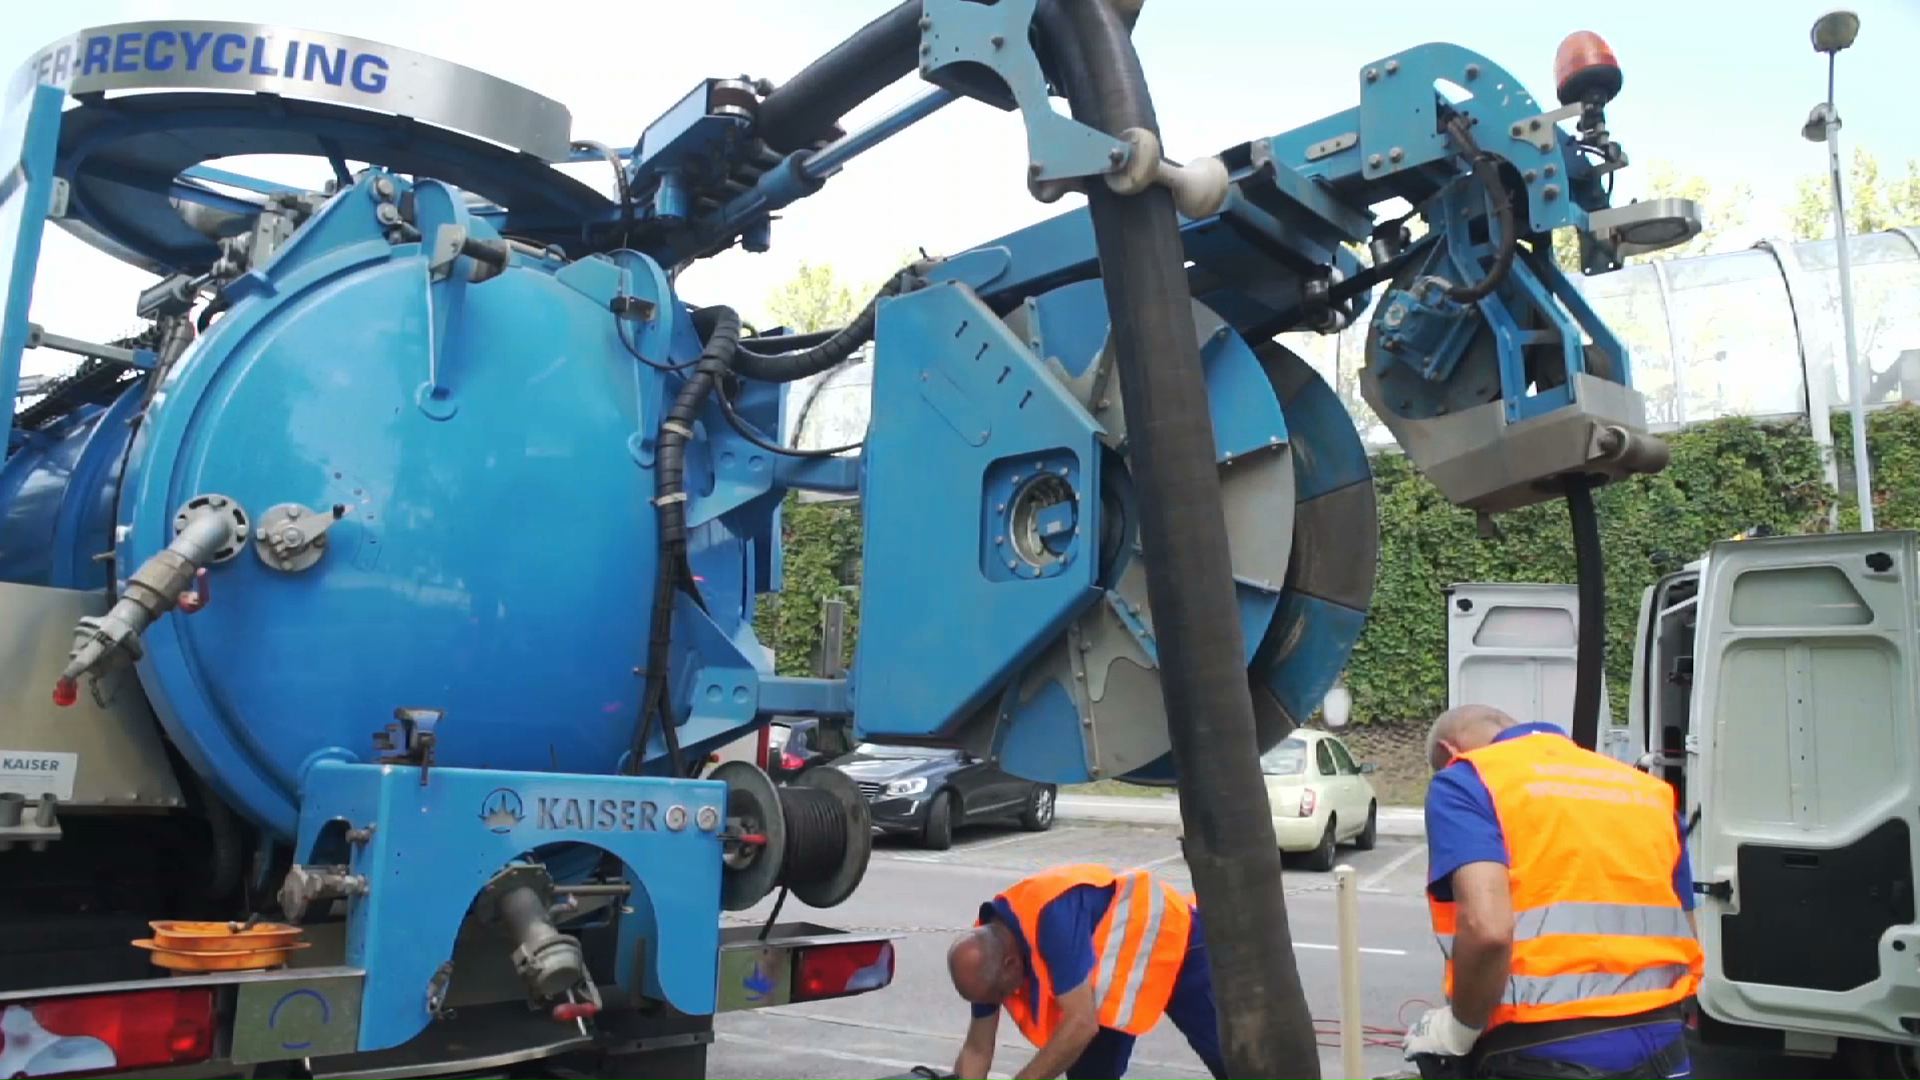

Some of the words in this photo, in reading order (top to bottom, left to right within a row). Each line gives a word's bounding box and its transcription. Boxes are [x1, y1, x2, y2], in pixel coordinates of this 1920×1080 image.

[32, 30, 390, 94] ER-RECYCLING
[3, 758, 60, 771] KAISER
[537, 797, 658, 832] KAISER
